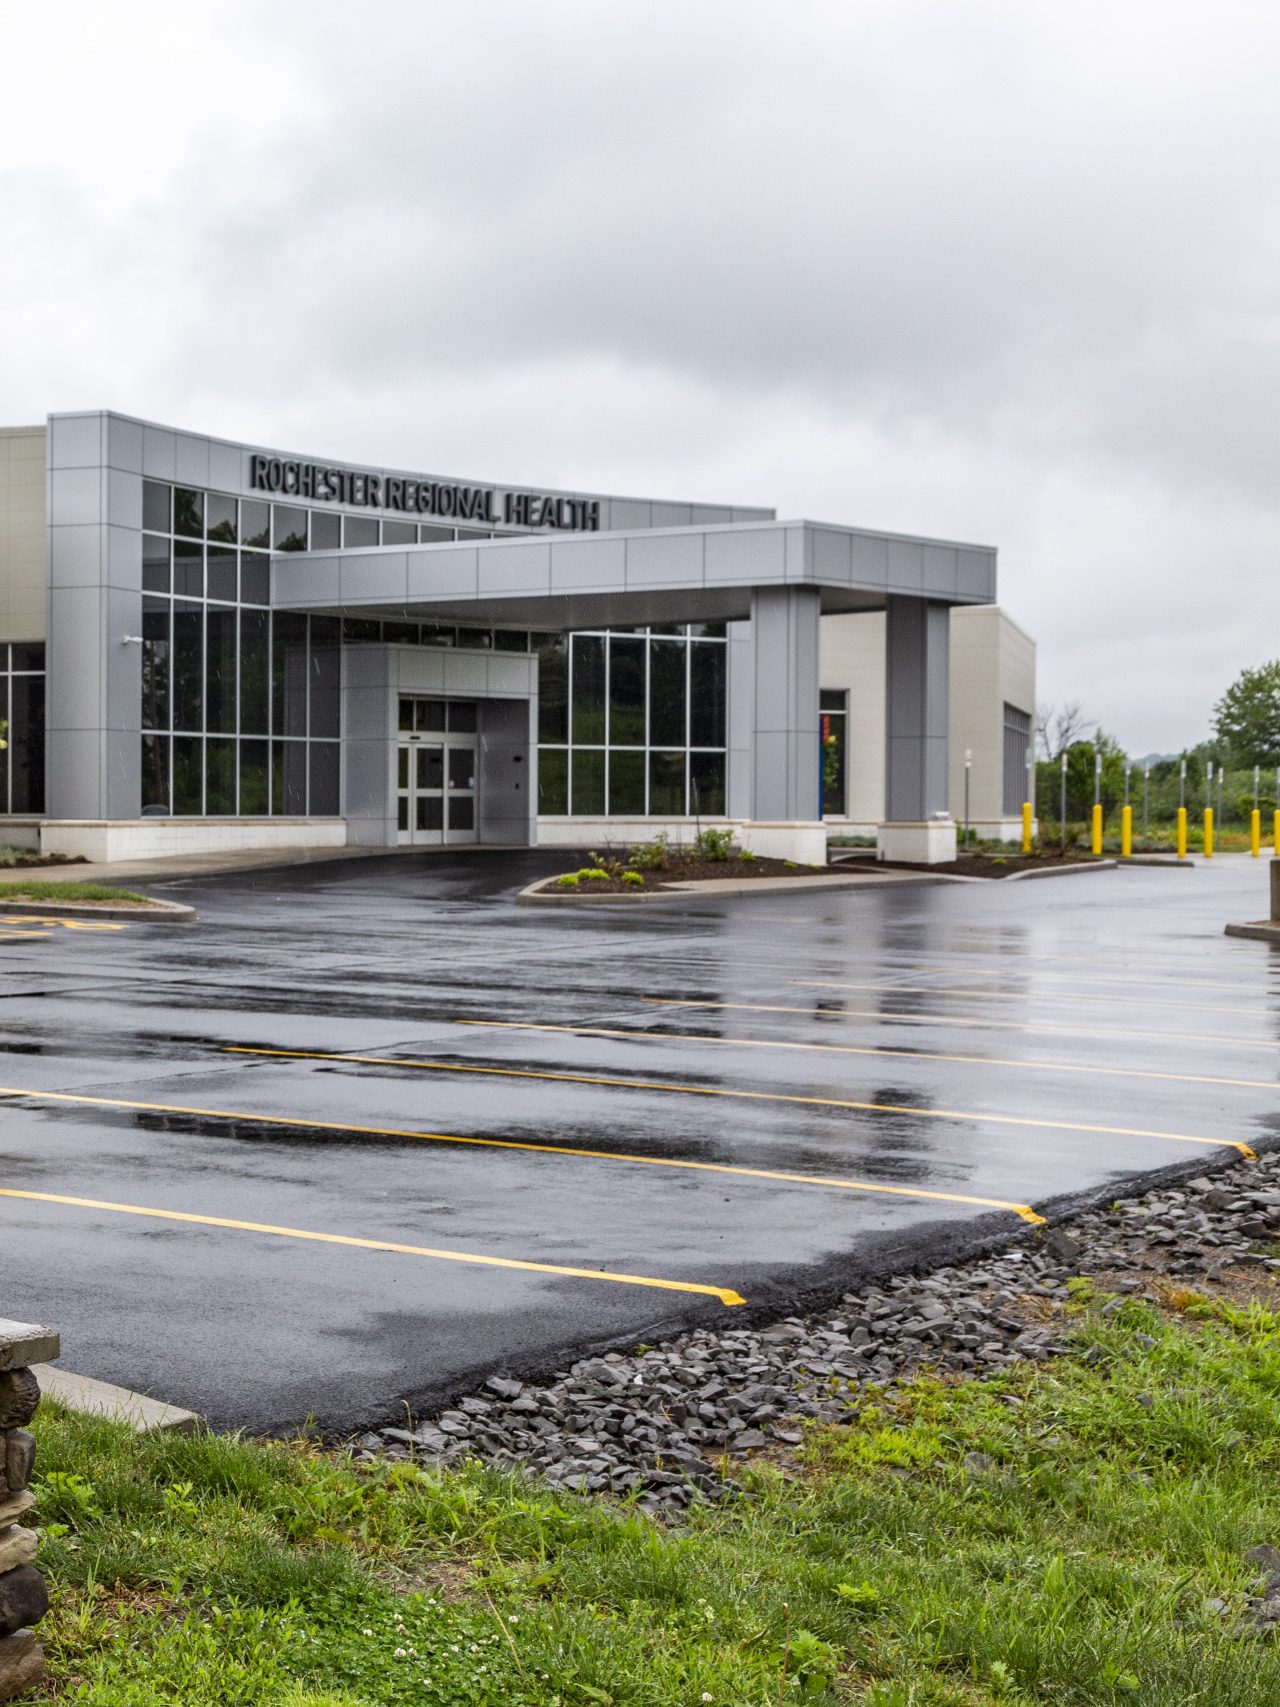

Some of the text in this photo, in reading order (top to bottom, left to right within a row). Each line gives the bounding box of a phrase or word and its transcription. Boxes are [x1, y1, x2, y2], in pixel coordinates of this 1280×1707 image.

[250, 454, 600, 531] ROCHESTER REGIONAL HEALTH
